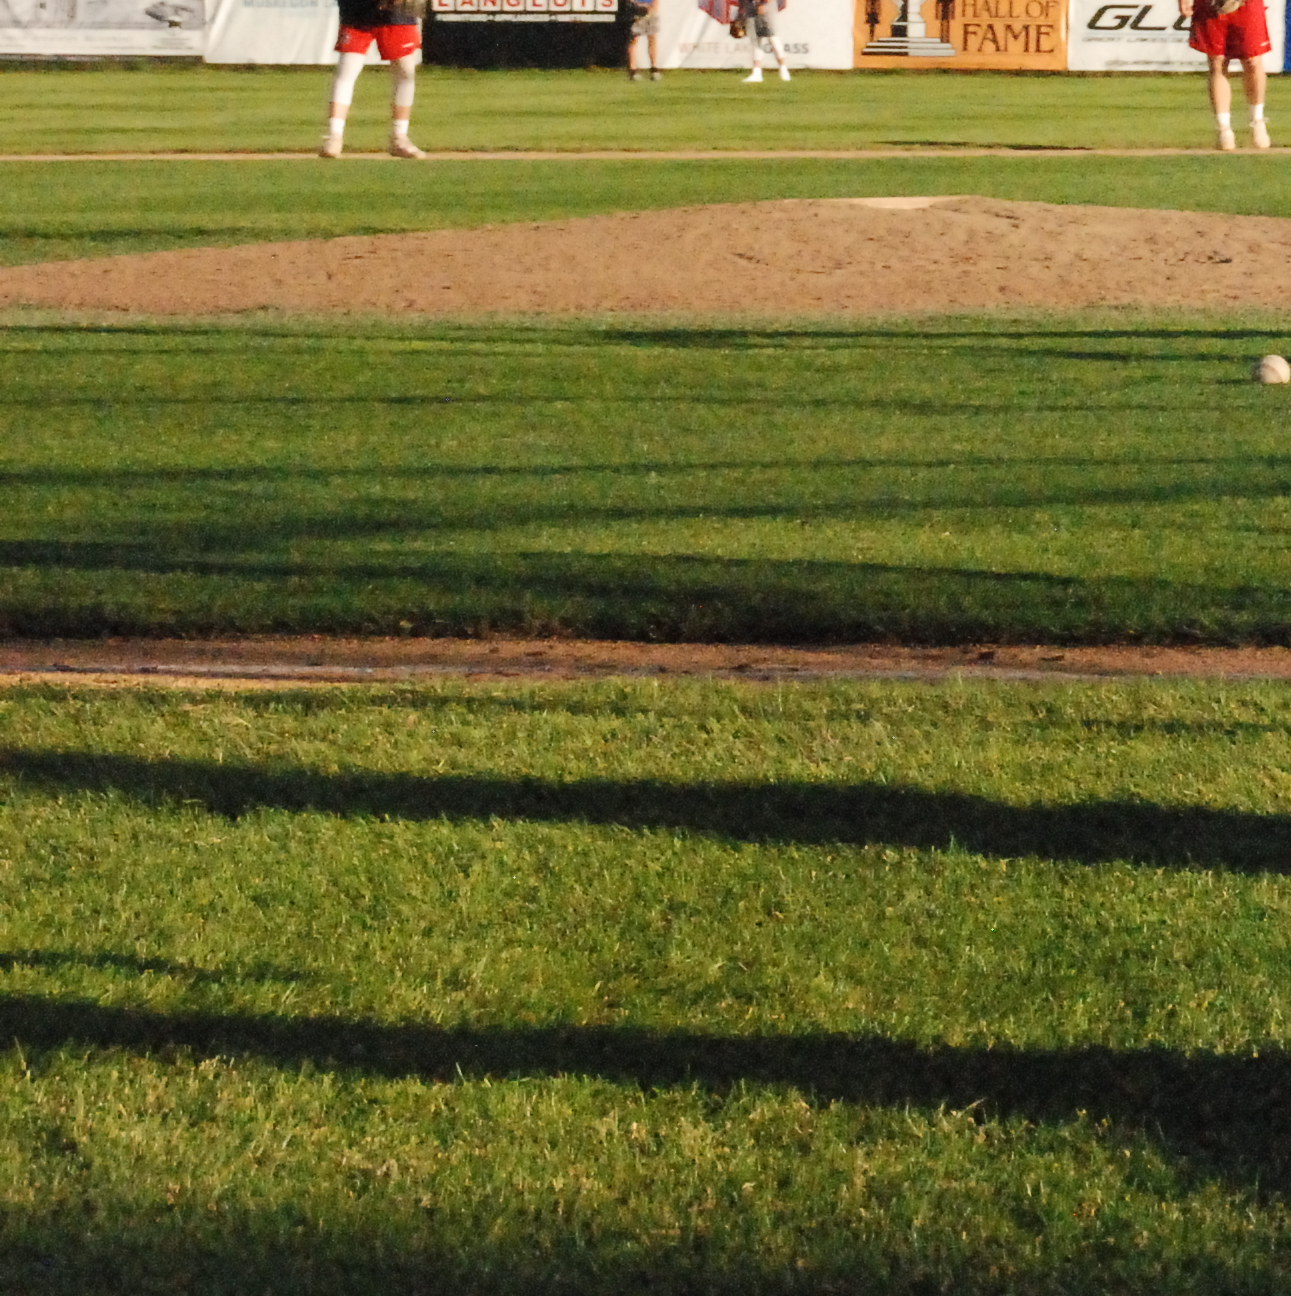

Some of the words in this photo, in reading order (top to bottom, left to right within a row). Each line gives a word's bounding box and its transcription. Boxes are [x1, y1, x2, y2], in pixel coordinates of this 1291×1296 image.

[961, 0, 1020, 19] HALL
[1024, 0, 1061, 19] OF
[761, 42, 809, 54] GASS
[961, 23, 1055, 54] FAME
